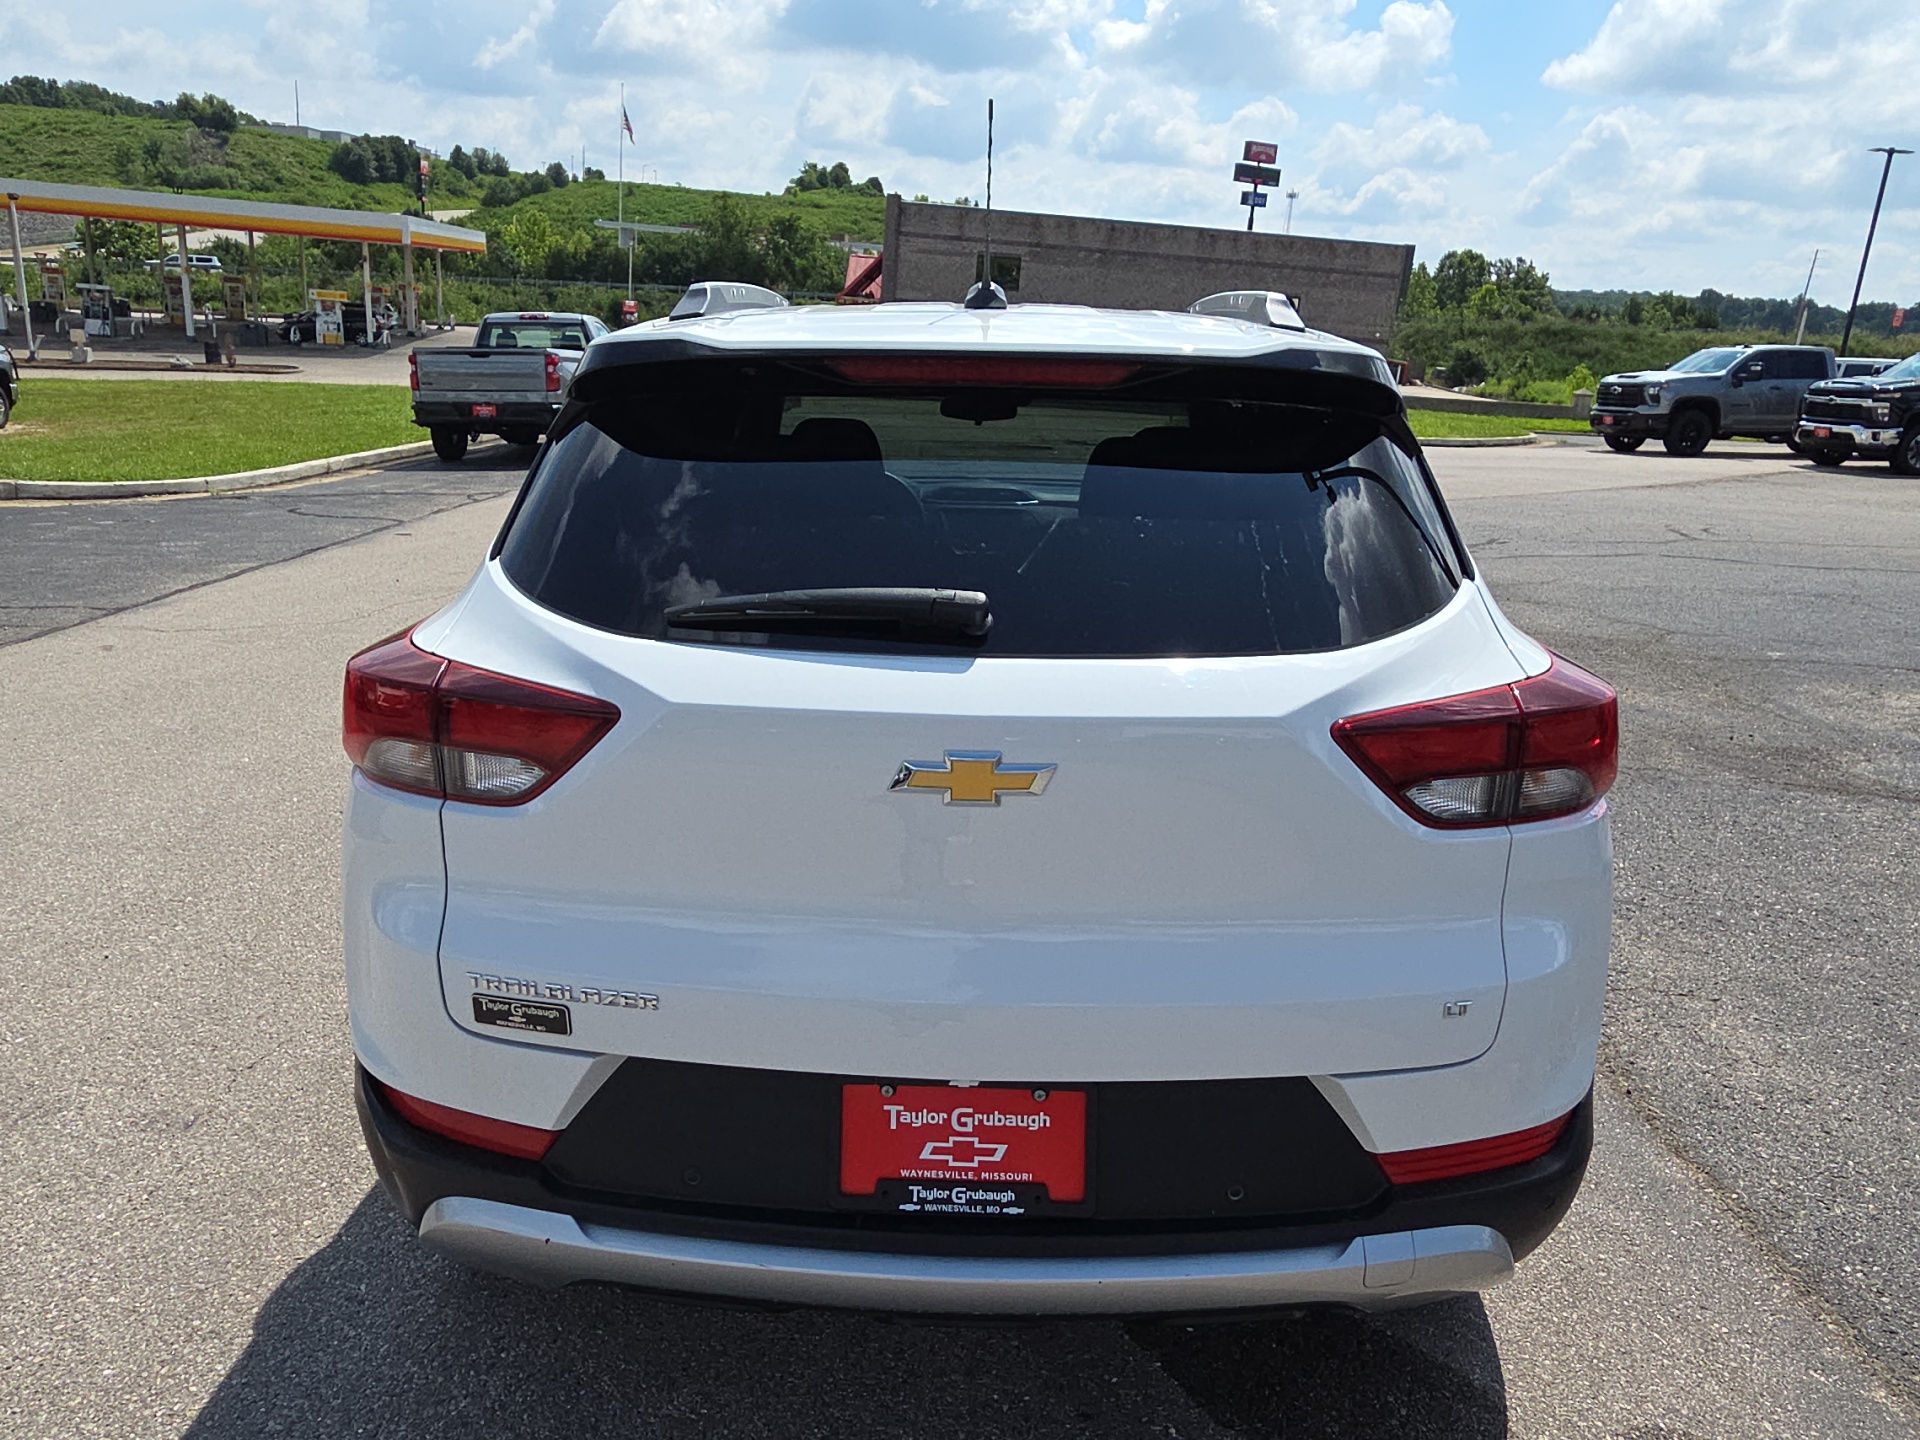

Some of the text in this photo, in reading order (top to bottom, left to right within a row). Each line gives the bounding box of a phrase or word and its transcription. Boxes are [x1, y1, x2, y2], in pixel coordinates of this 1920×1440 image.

[465, 971, 660, 1011] TRAILBLAZER
[478, 998, 560, 1019] Taylor Grubaugh
[1443, 1000, 1473, 1018] LT
[883, 1105, 1051, 1132] Taylor Grubaugh
[900, 1169, 1033, 1182] WAYNESVILLE, MISSOURI
[908, 1185, 1015, 1204] Taylor Grubaugh
[924, 1204, 1000, 1214] WAYNESVILLE, MO
